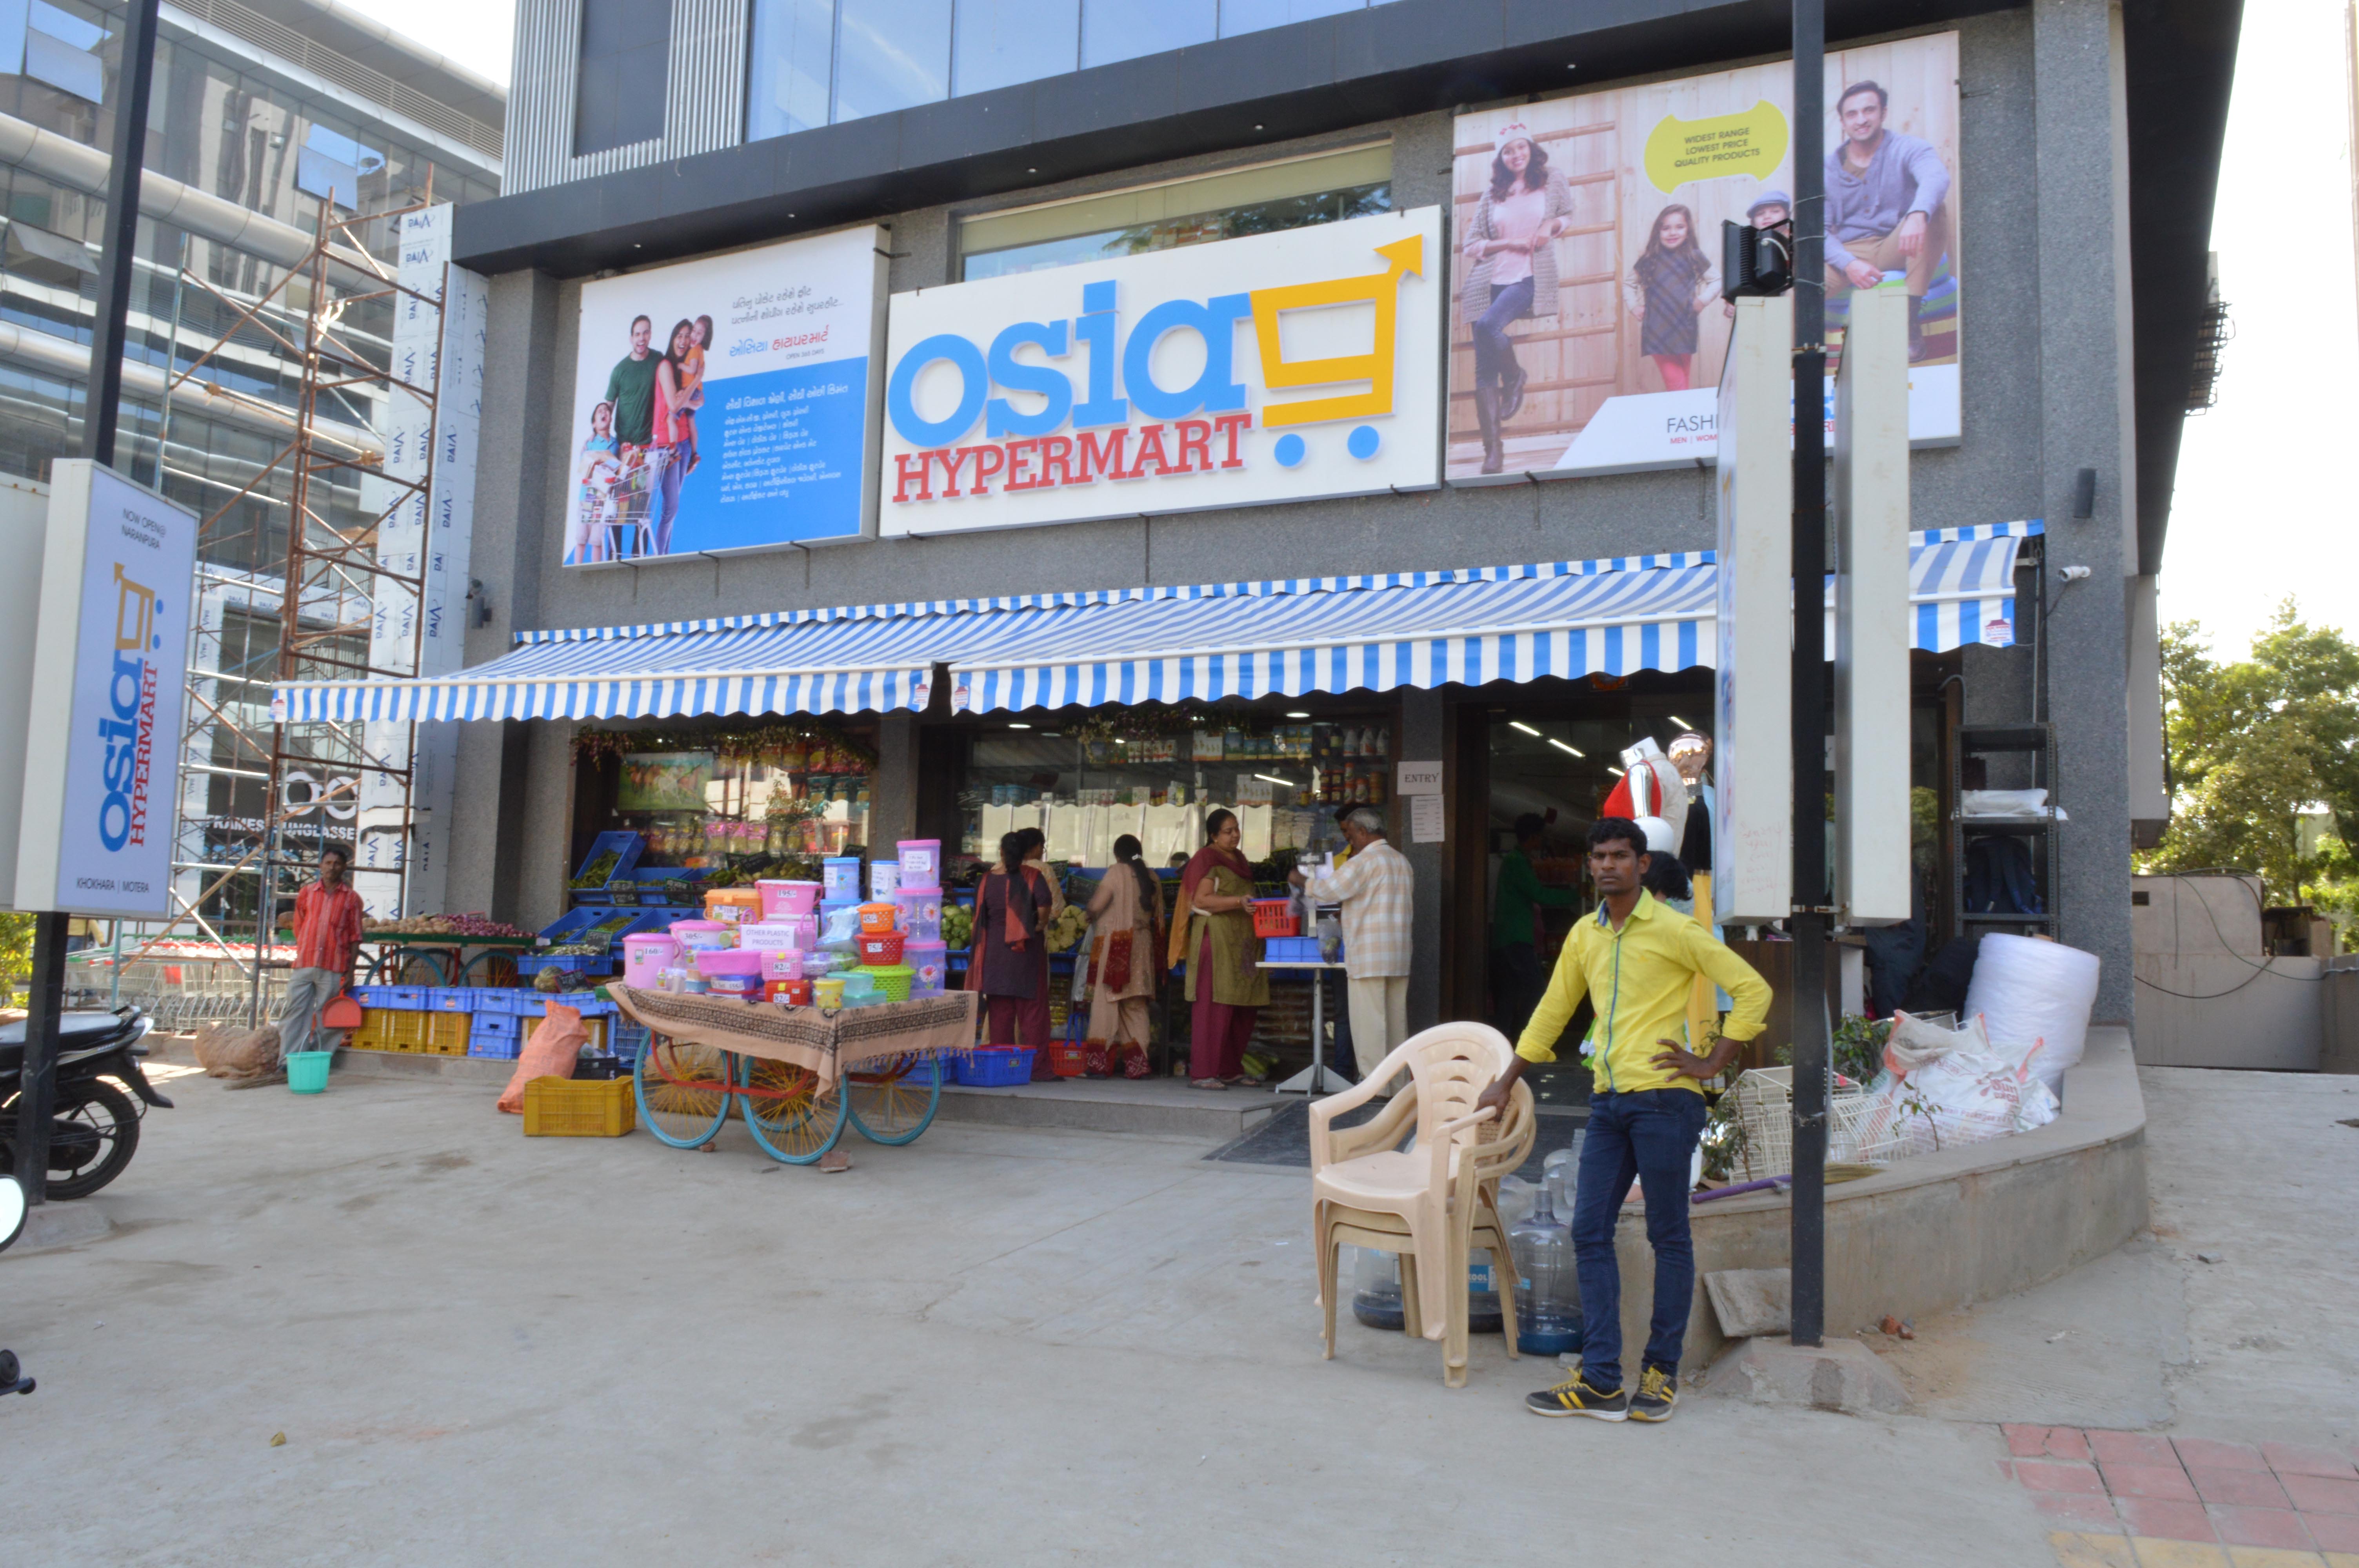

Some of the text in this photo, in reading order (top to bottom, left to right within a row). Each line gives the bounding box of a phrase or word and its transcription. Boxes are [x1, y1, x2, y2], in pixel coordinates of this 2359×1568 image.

[1685, 127, 1750, 144] WIDEST RANGE
[1686, 139, 1748, 155] LOWEST PRICE
[1674, 148, 1760, 167] QUALITY PRODUCTS
[888, 279, 1252, 448] osia
[1670, 436, 1687, 444] MEN
[892, 414, 1252, 503] HYPERMART
[123, 508, 140, 524] NOW
[98, 650, 144, 852] osia
[130, 661, 158, 846] HYPERMART
[1405, 773, 1439, 783] ENTRY
[76, 878, 149, 893] KHOKHARA MOTERA
[774, 963, 789, 971] 82/-
